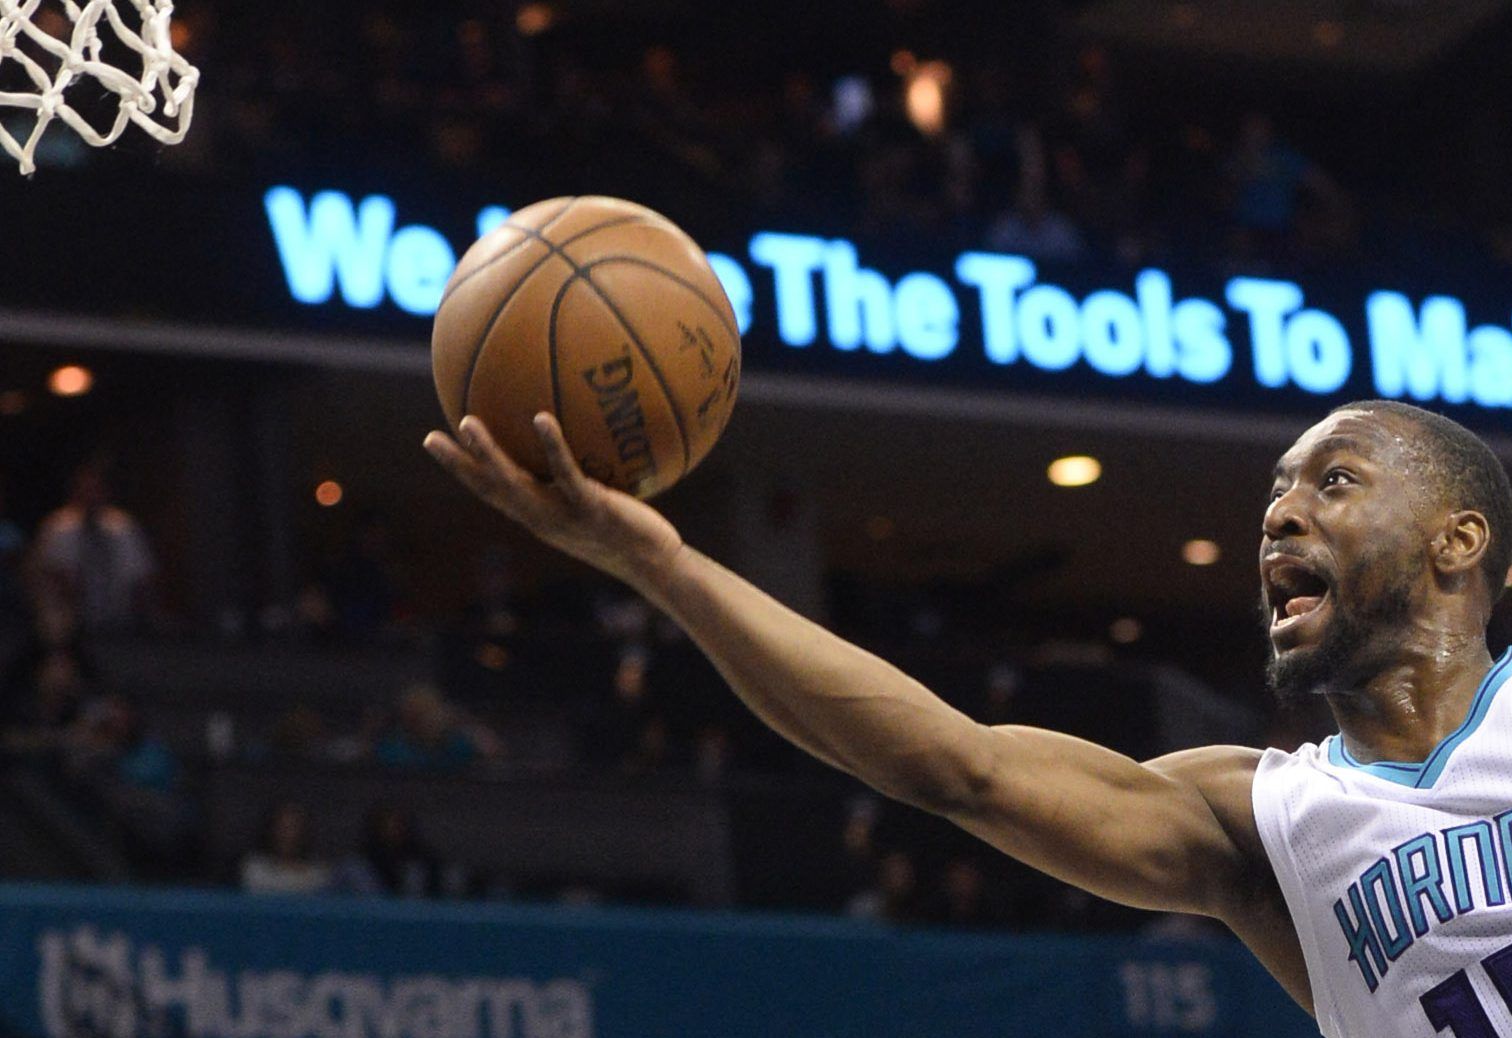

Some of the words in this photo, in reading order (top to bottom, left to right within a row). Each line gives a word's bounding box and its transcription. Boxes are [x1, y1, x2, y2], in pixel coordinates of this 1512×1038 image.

[264, 186, 458, 316] We
[750, 232, 959, 360] The
[955, 252, 1232, 383] Tools
[1227, 276, 1352, 394] To
